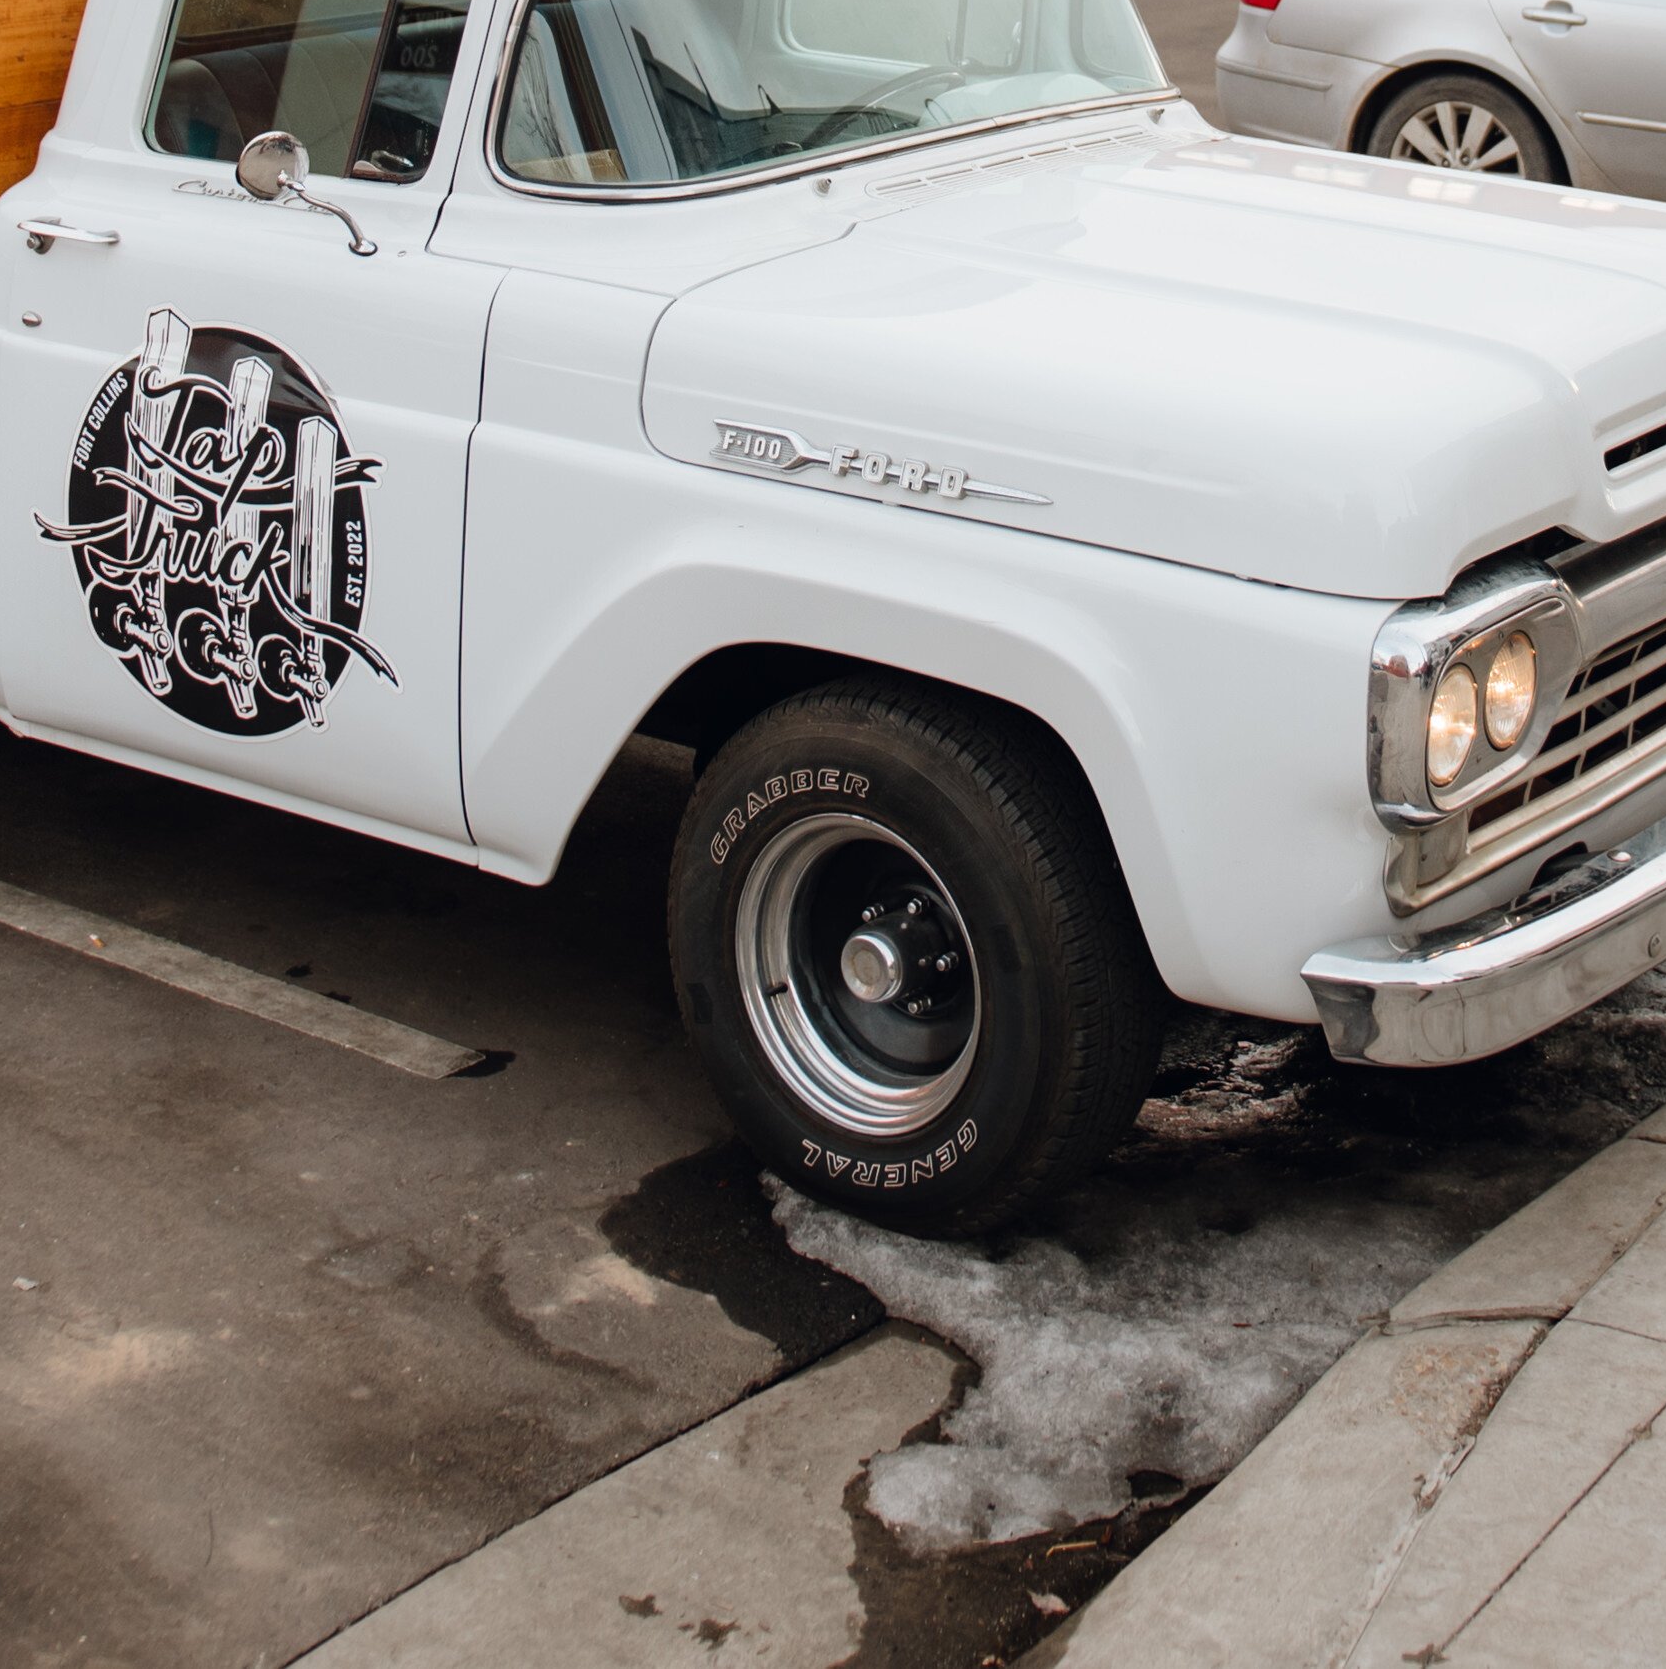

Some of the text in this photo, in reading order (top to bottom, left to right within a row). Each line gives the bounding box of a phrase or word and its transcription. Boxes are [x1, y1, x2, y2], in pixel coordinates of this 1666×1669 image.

[73, 371, 129, 471] FORT COLLINS
[126, 364, 287, 524] Tap
[722, 429, 969, 501] F-100 FORD
[85, 467, 291, 597] Truck
[344, 520, 364, 609] EST. 2022
[710, 769, 871, 866] GRABBER
[801, 1118, 979, 1188] GENERAL
